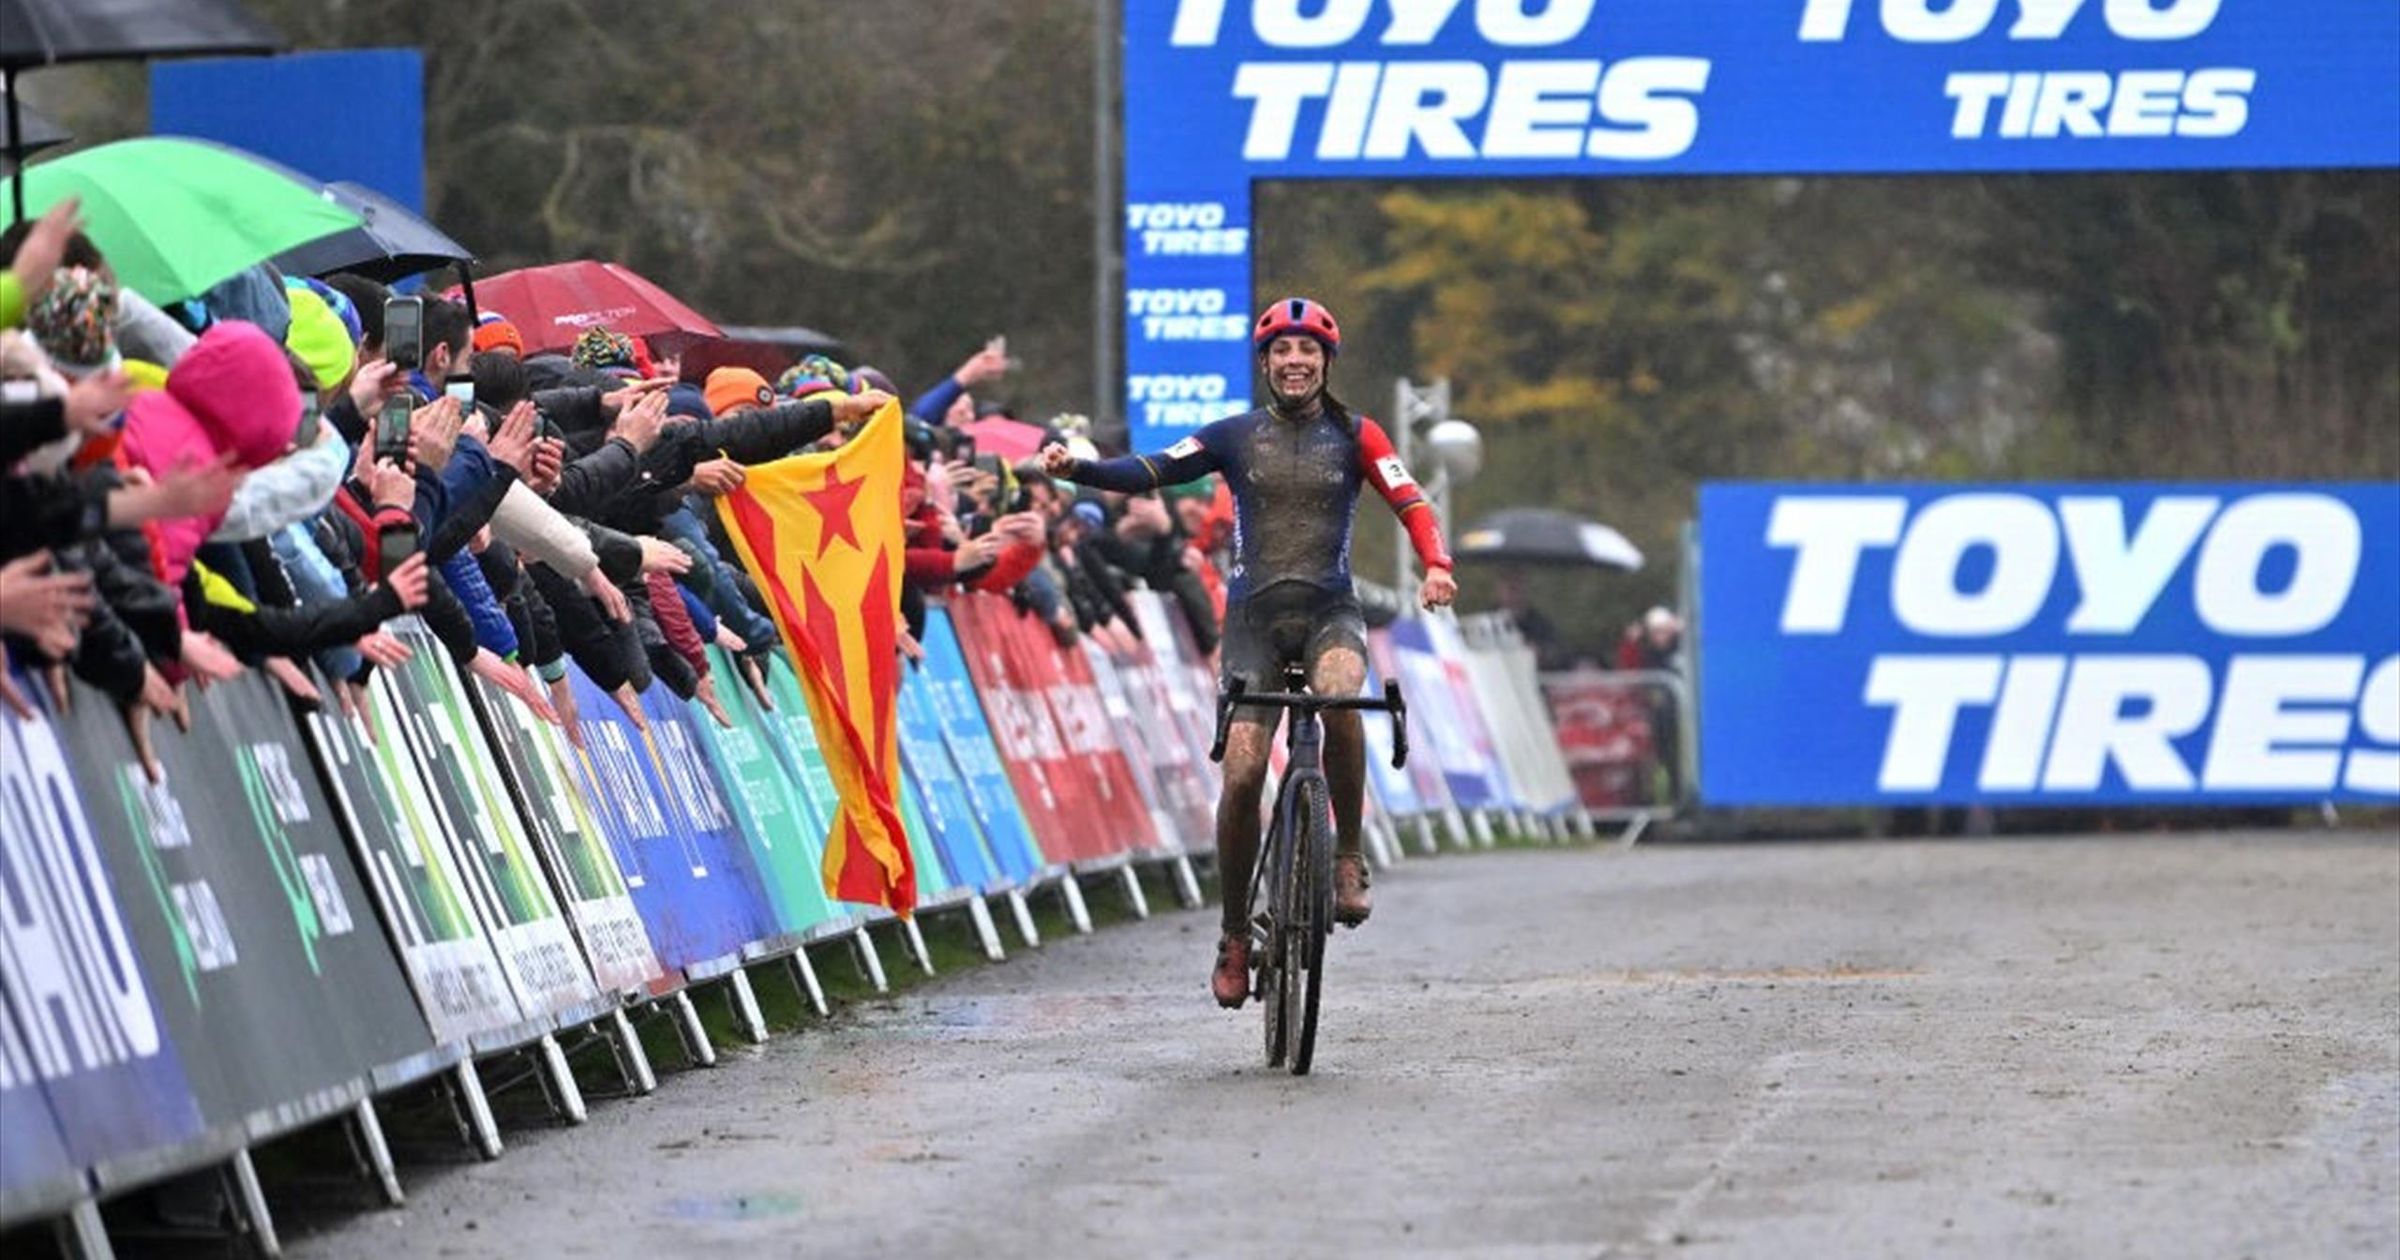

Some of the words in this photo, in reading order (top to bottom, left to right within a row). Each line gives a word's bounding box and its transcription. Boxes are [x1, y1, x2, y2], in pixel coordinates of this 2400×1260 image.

[1232, 57, 1712, 161] TIRES
[1944, 67, 2257, 139] TIRES
[1126, 203, 1225, 229] TOYO
[1143, 228, 1249, 255] TIRES
[1127, 288, 1225, 315] TOYO
[1143, 314, 1249, 340] TIRES
[1127, 374, 1227, 400] TOYO
[1765, 492, 2363, 638] TOYO
[0, 704, 160, 1090] ANO
